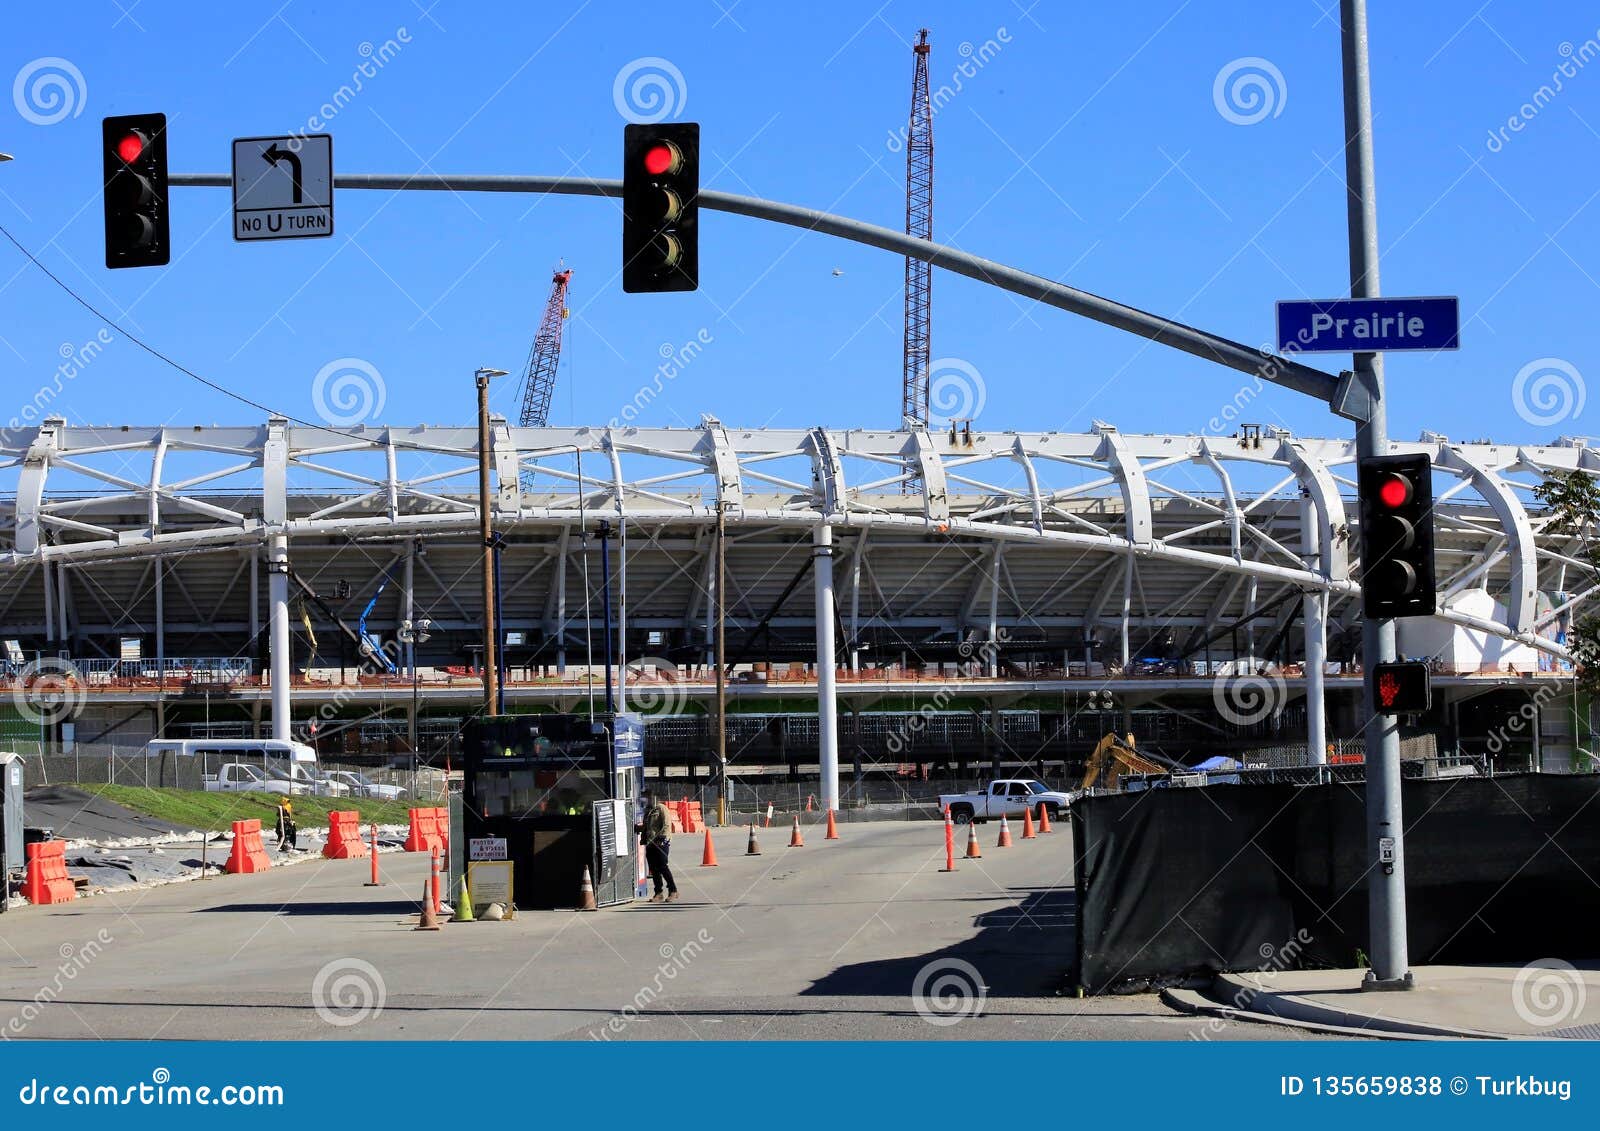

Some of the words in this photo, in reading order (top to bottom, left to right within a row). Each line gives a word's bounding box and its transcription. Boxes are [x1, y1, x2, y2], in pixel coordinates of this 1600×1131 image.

[242, 218, 262, 232] NO
[267, 213, 282, 232] U
[288, 214, 326, 230] TURN
[1311, 311, 1425, 340] Prairie
